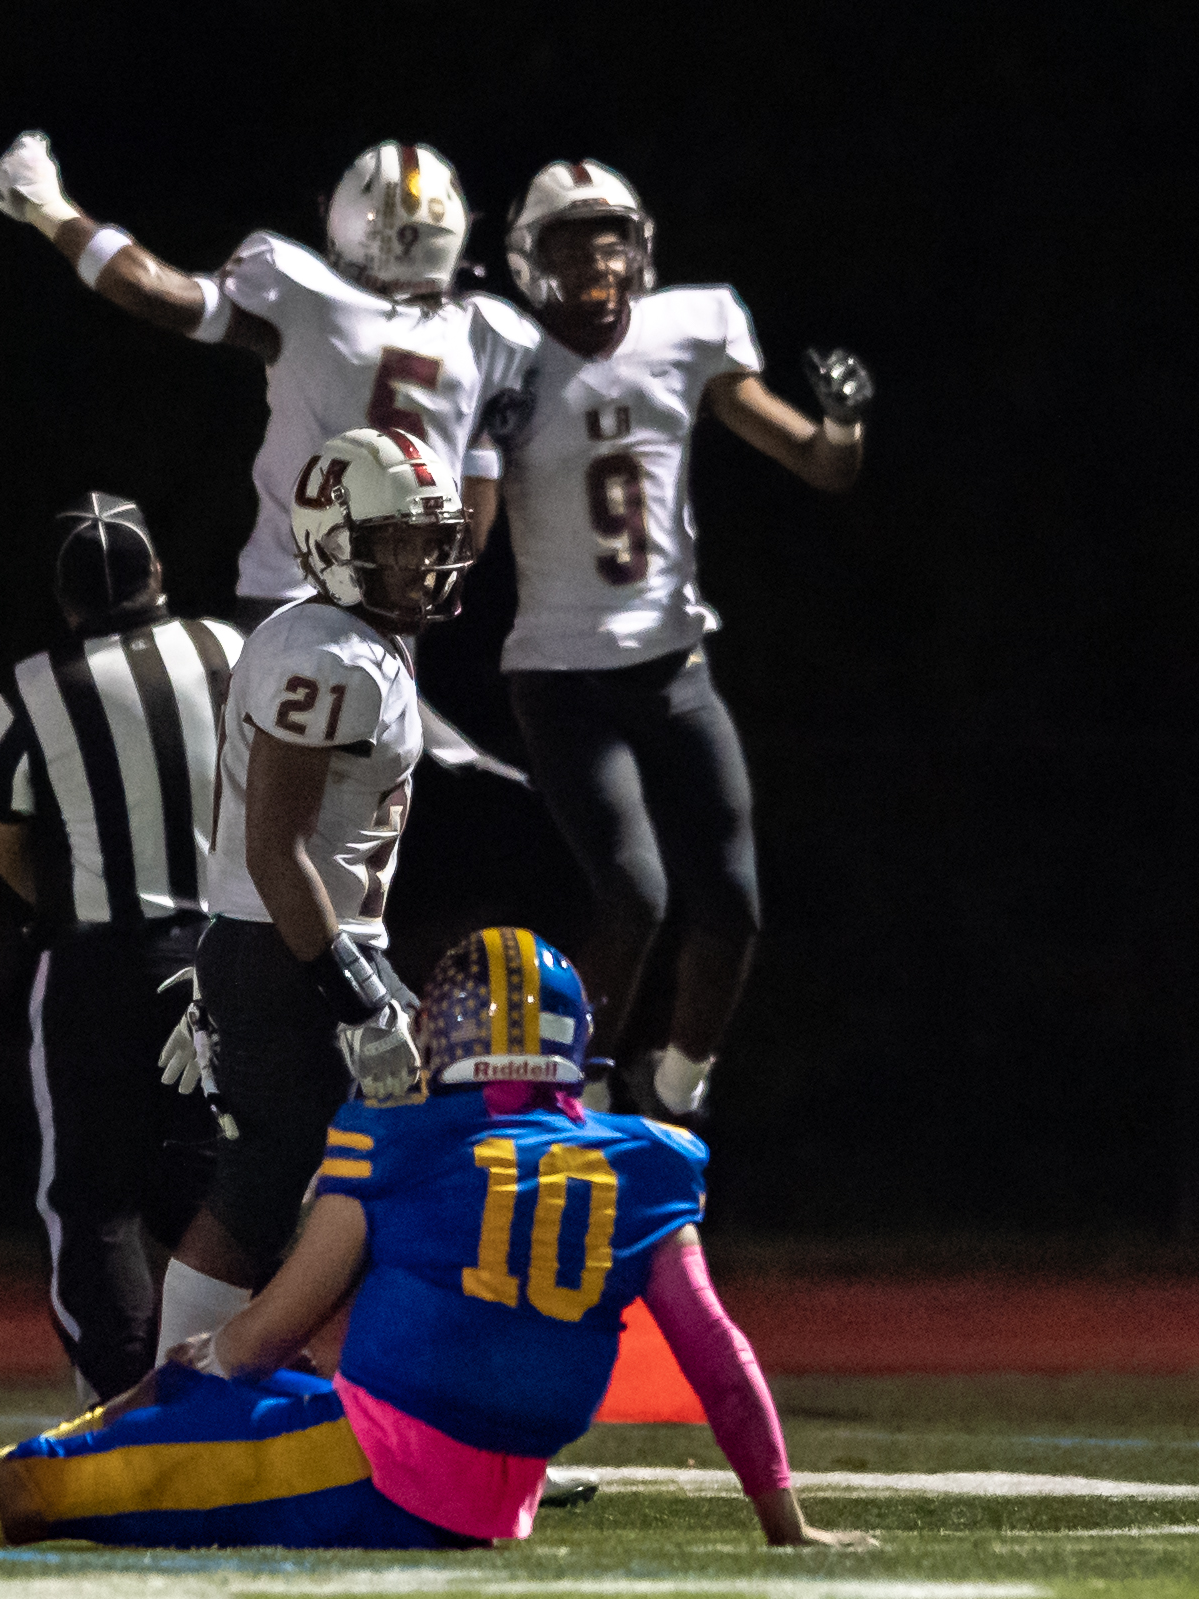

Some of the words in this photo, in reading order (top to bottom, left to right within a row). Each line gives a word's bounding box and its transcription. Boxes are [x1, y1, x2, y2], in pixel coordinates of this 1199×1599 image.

[586, 452, 648, 586] 9
[275, 673, 347, 741] 21
[472, 1060, 558, 1082] Riddell
[461, 1136, 619, 1322] 10
